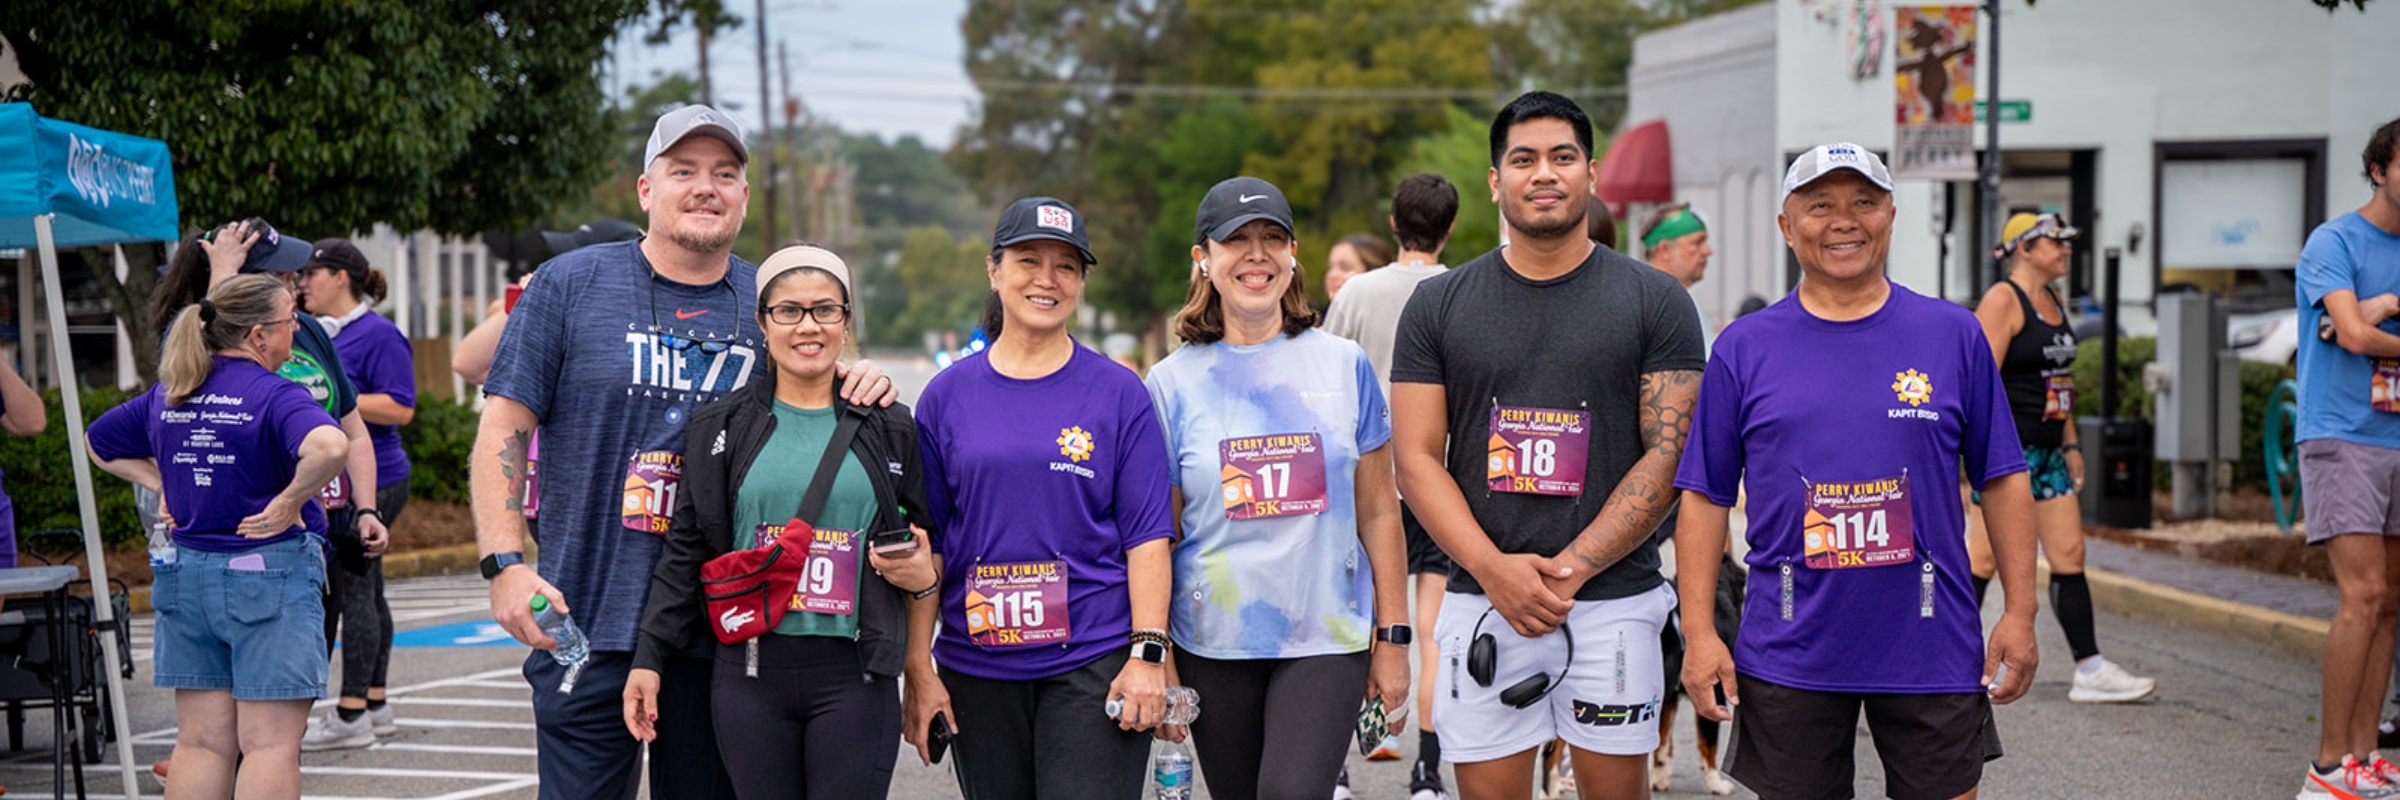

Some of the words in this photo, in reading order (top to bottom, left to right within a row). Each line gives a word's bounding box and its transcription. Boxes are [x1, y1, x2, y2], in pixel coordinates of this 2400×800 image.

[628, 323, 753, 346] CHICAGO
[626, 333, 692, 391] THE
[627, 388, 719, 402] BASEB
[1501, 409, 1532, 421] PERRY
[1535, 411, 1580, 425] KIWANIS
[1888, 409, 1915, 418] KAPIT
[1498, 419, 1526, 432] Georgia
[1230, 438, 1263, 451] PERRY
[1266, 435, 1311, 447] KIWANIS
[640, 452, 673, 464] PERRY
[1229, 449, 1259, 462] Georgia
[1517, 438, 1556, 476] 18
[1256, 462, 1290, 499] 17
[1514, 476, 1538, 492] 5K
[1816, 483, 1850, 496] PERRY
[1853, 479, 1899, 494] KIWANIS
[649, 479, 678, 517] 11
[1813, 493, 1845, 508] Georgia
[1256, 500, 1281, 516] 5K
[651, 516, 671, 532] 5K
[1829, 510, 1890, 549] 114
[812, 529, 849, 543] WANIS
[1838, 550, 1865, 566] 5K
[797, 556, 834, 595] 19
[977, 565, 1008, 577] PERRY
[1012, 563, 1056, 576] KIWANIS
[975, 576, 1004, 589] Georgia
[988, 591, 1044, 628] 115
[999, 629, 1023, 643] 5K
